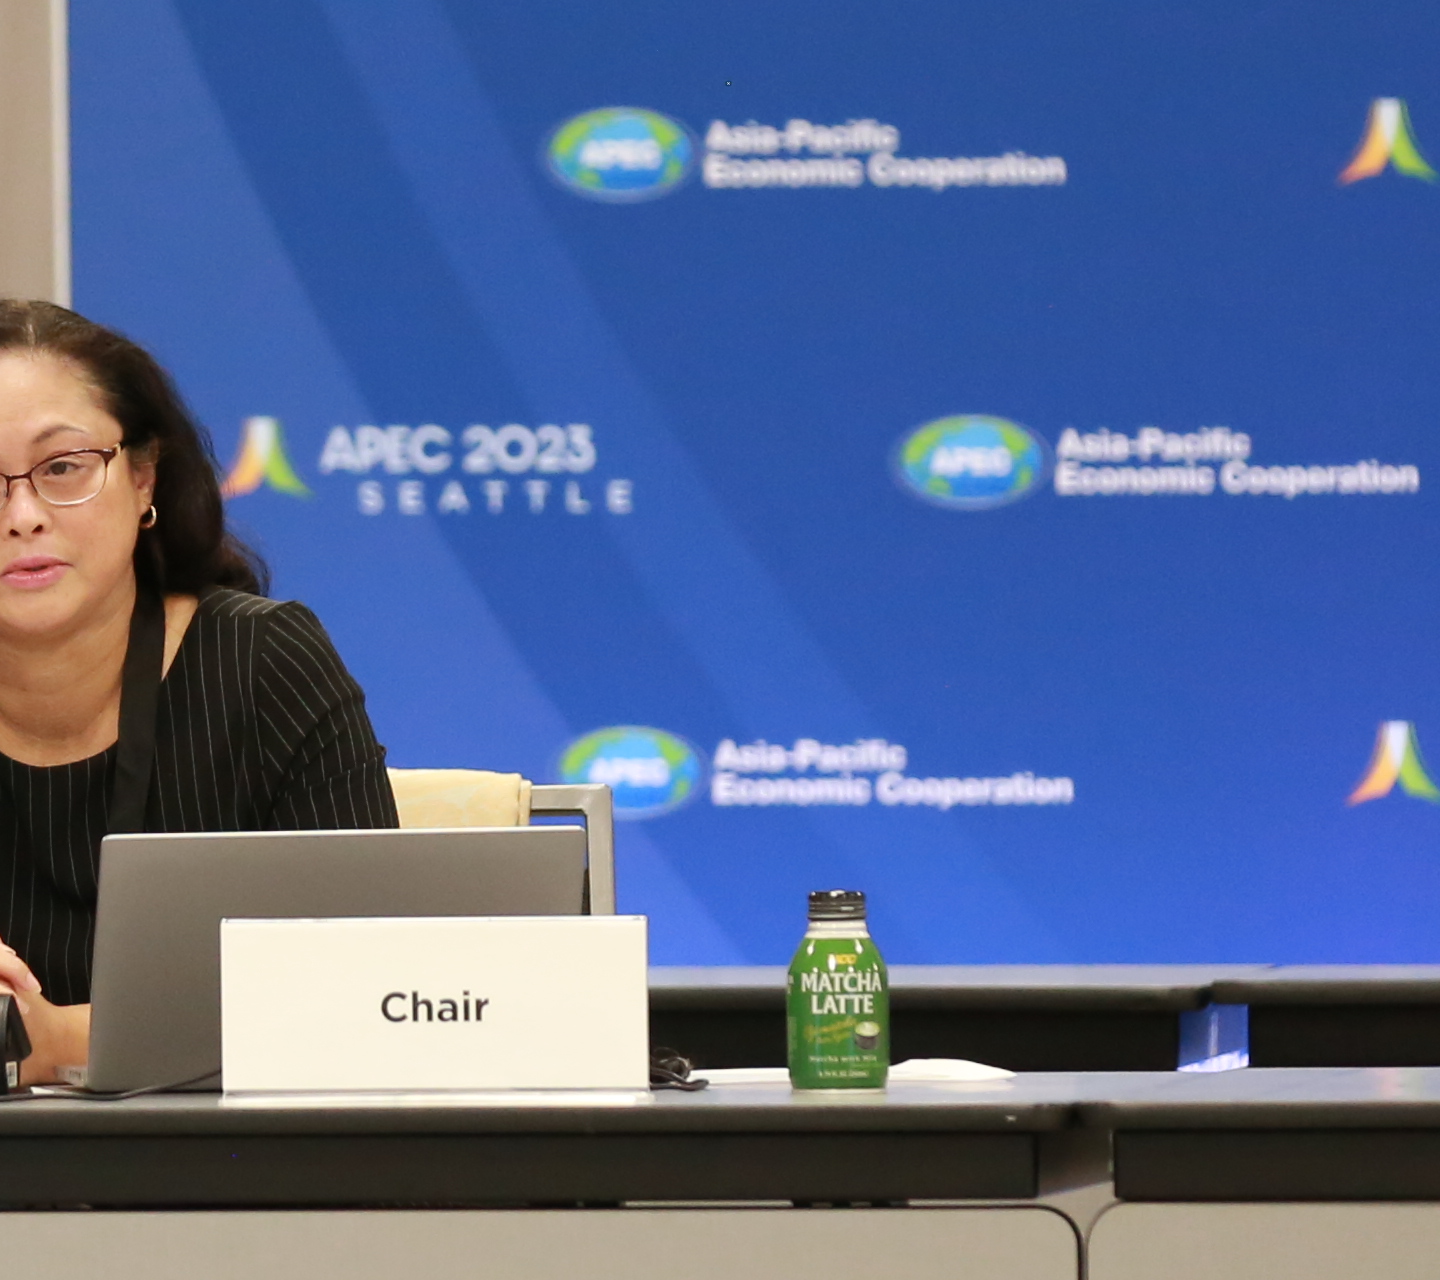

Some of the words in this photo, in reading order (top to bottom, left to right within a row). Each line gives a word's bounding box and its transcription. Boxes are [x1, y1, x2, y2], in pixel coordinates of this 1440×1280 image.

[704, 118, 899, 154] Asia-Pacific
[702, 152, 861, 189] Economic
[868, 147, 1067, 191] Cooperation
[319, 424, 451, 474] APEC
[463, 423, 597, 474] 2023
[1056, 426, 1251, 462] Asia-Pacific
[1054, 459, 1215, 496] Economic
[1220, 455, 1421, 499] Cooperation
[357, 478, 632, 516] SEATTLE
[876, 767, 1075, 809] Cooperation
[801, 971, 882, 993] MATCHA
[380, 990, 490, 1023] Chair
[811, 993, 874, 1015] LATTE
